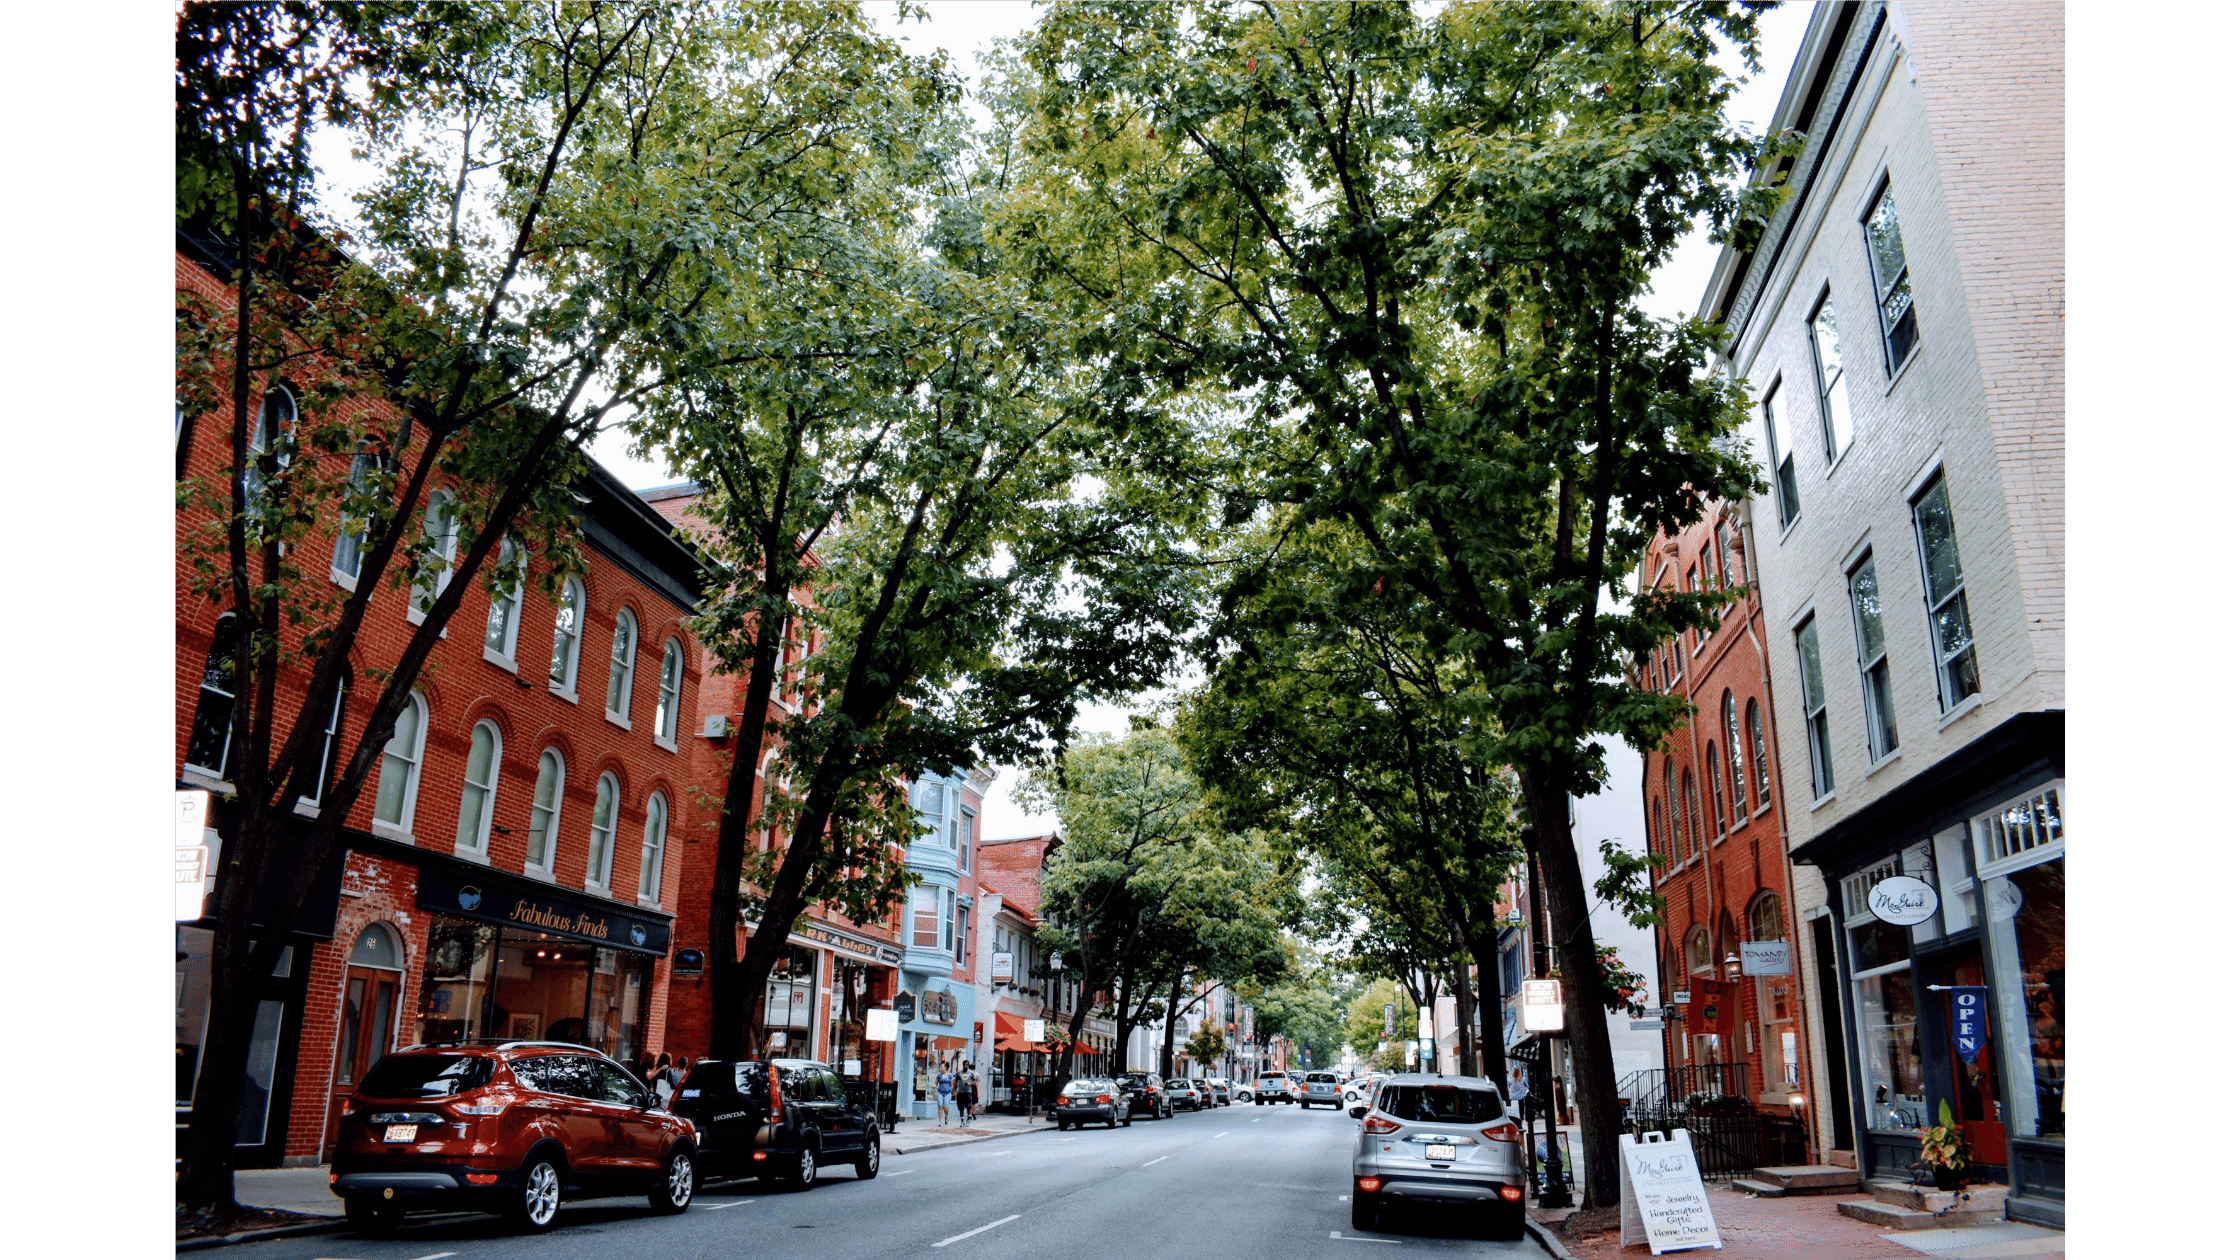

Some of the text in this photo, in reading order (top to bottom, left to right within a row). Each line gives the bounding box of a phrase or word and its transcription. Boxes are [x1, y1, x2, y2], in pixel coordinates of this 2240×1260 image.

[1875, 886, 1924, 914] McGuire
[510, 898, 608, 939] Fabulous Finds
[1957, 994, 1976, 1050] OPEN
[713, 1111, 747, 1122] HONDA
[1636, 1155, 1683, 1178] McGuire
[1666, 1194, 1700, 1204] Jewelry
[1649, 1206, 1703, 1217] Handcrafted
[1667, 1216, 1691, 1226] Gifts
[1654, 1226, 1709, 1237] Home Decor
